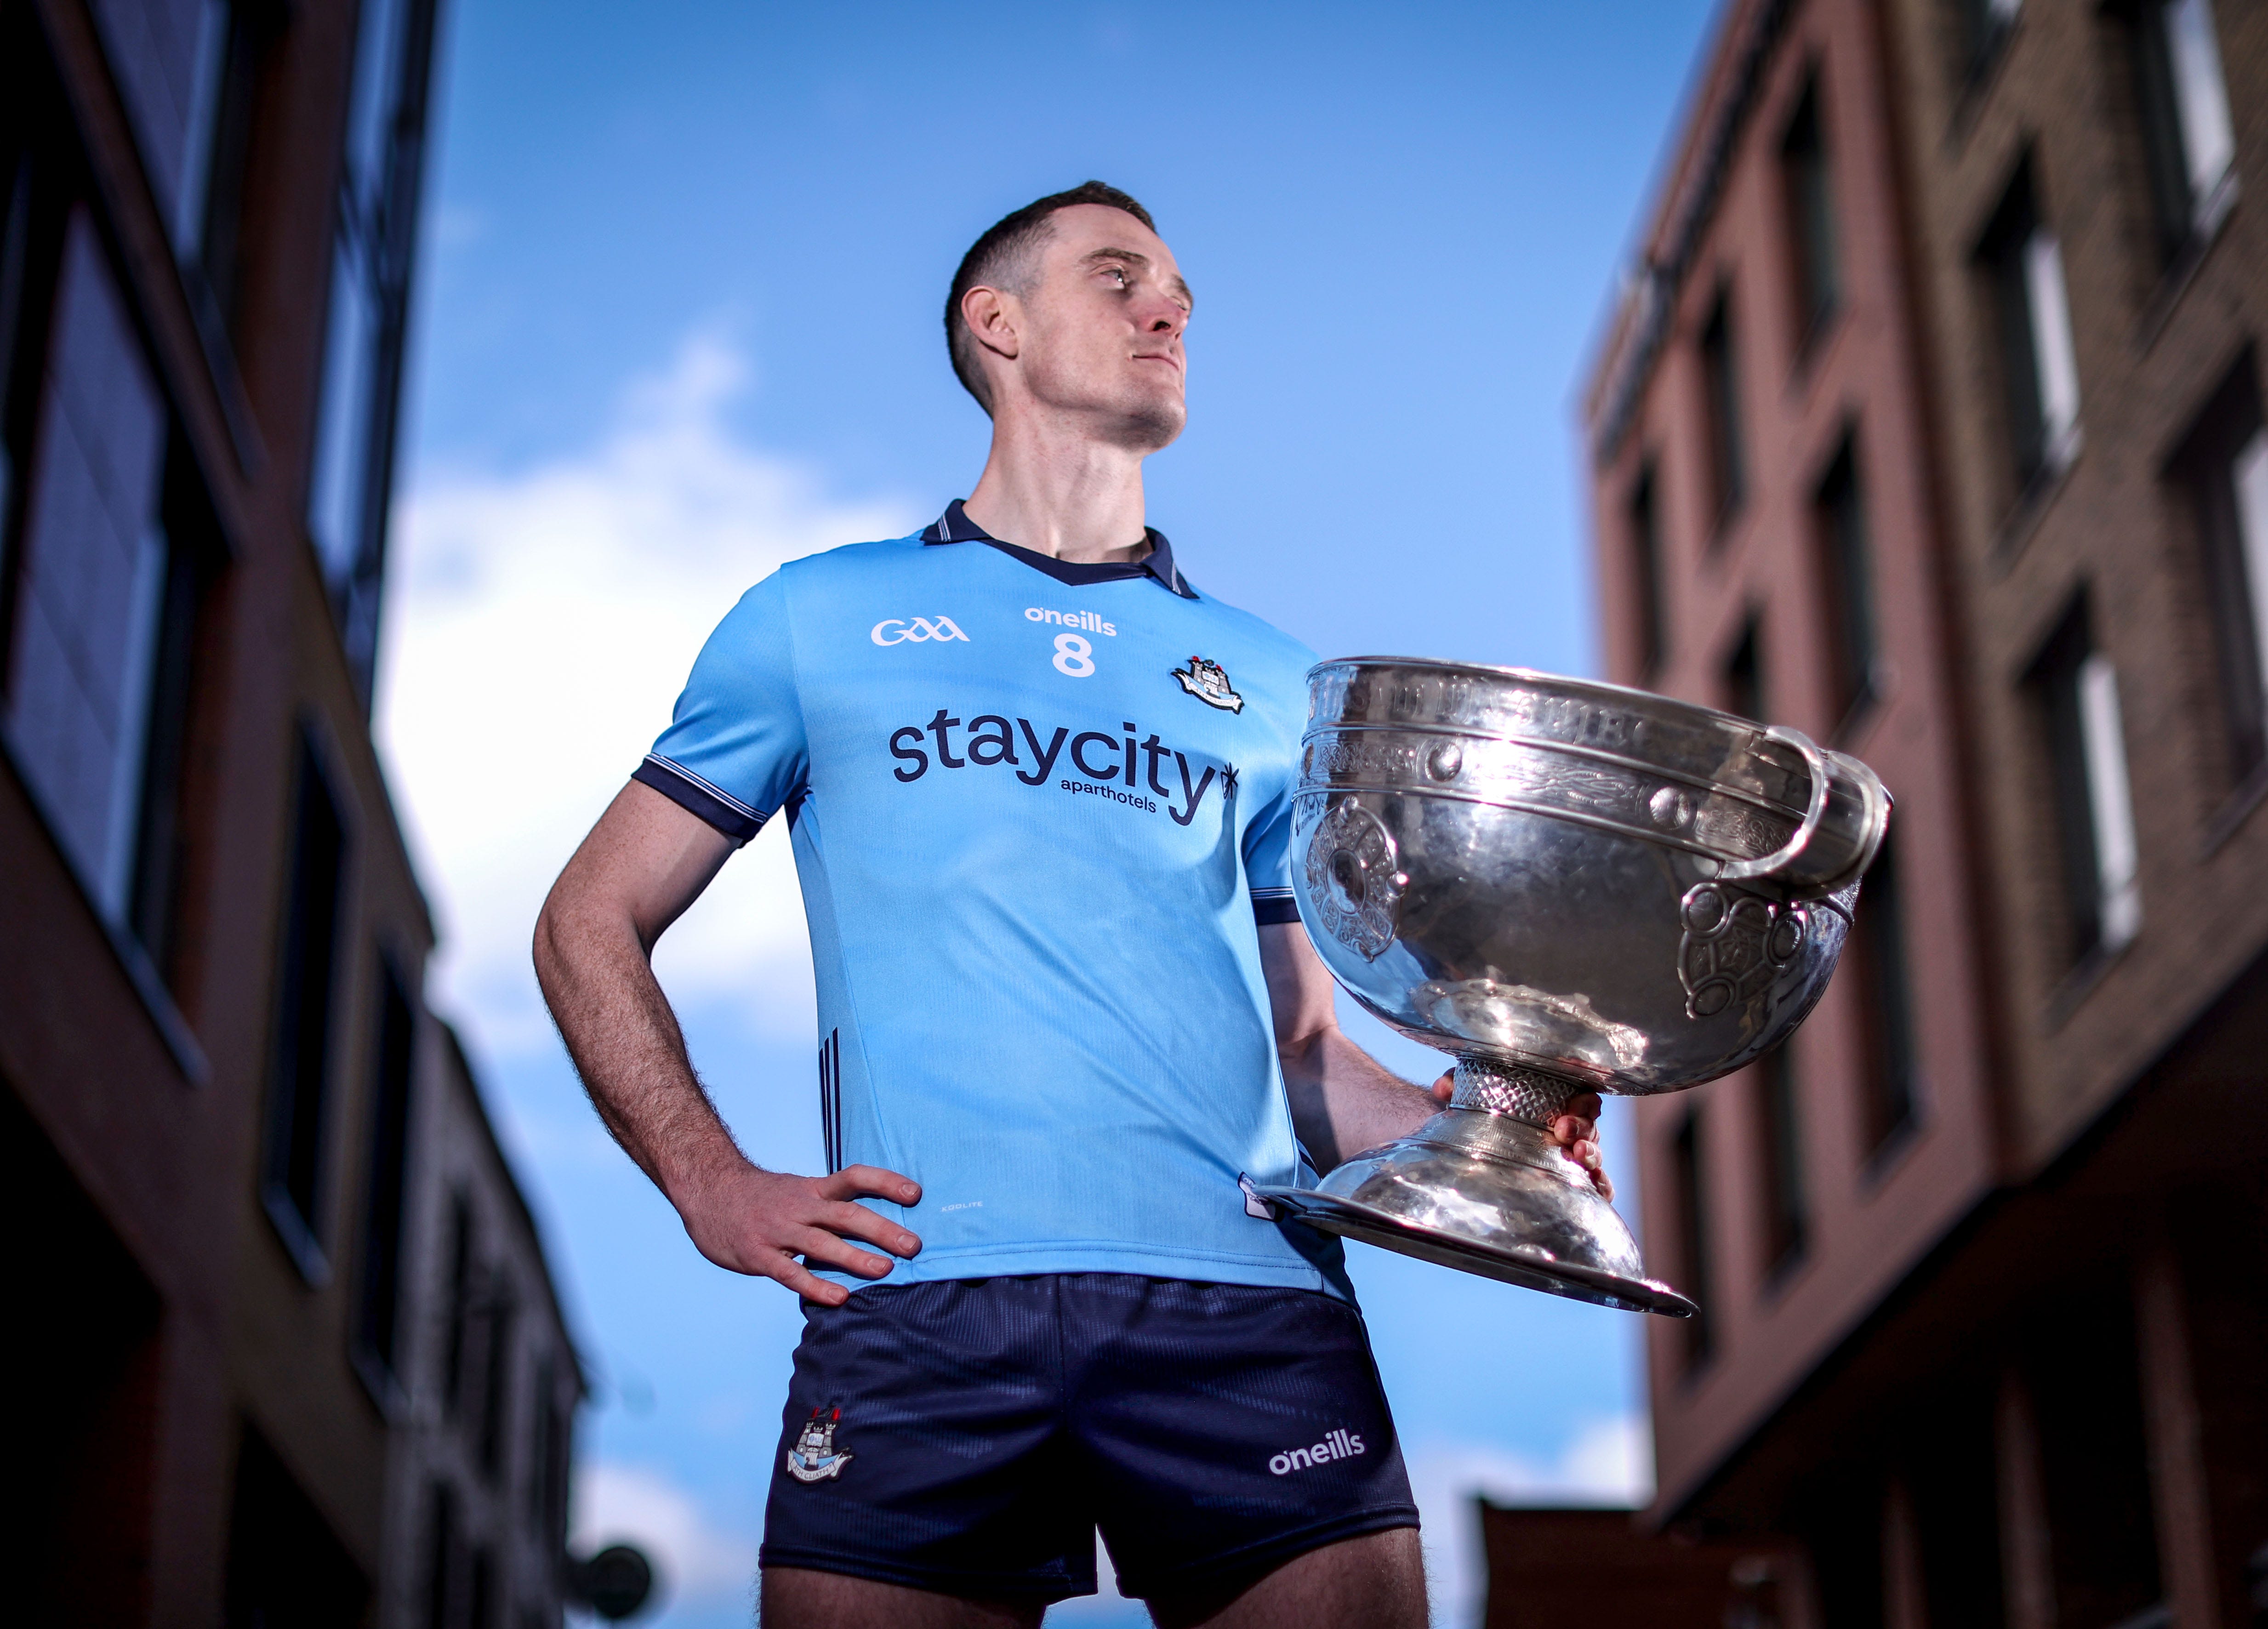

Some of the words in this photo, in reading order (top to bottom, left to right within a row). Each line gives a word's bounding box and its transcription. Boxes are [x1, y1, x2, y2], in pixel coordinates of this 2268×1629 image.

[871, 615, 970, 646] GAA
[1052, 633, 1095, 678] 8
[1061, 780, 1157, 813] aparthotels
[941, 1201, 983, 1212] KOOLITE
[804, 1468, 829, 1479] CLIATH
